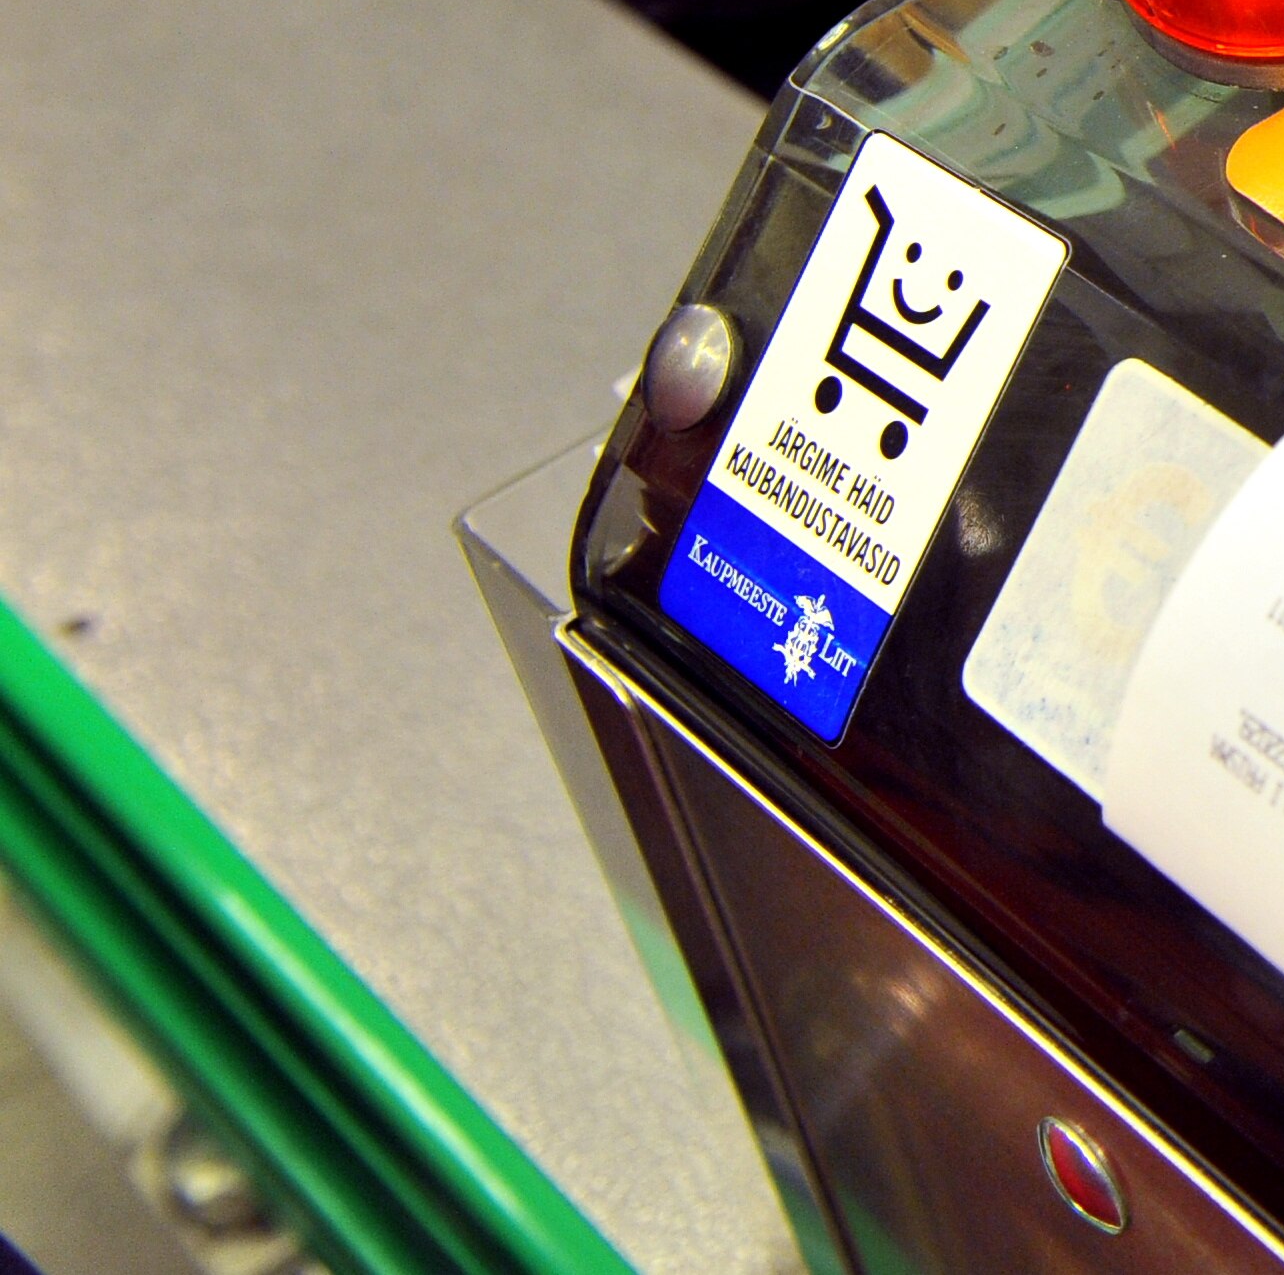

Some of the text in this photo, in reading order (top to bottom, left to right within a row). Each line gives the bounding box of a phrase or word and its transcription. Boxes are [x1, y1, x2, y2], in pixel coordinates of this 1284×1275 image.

[726, 443, 902, 587] KAUBANDUSTAVASID
[767, 417, 897, 527] JÄRGIME HÄID
